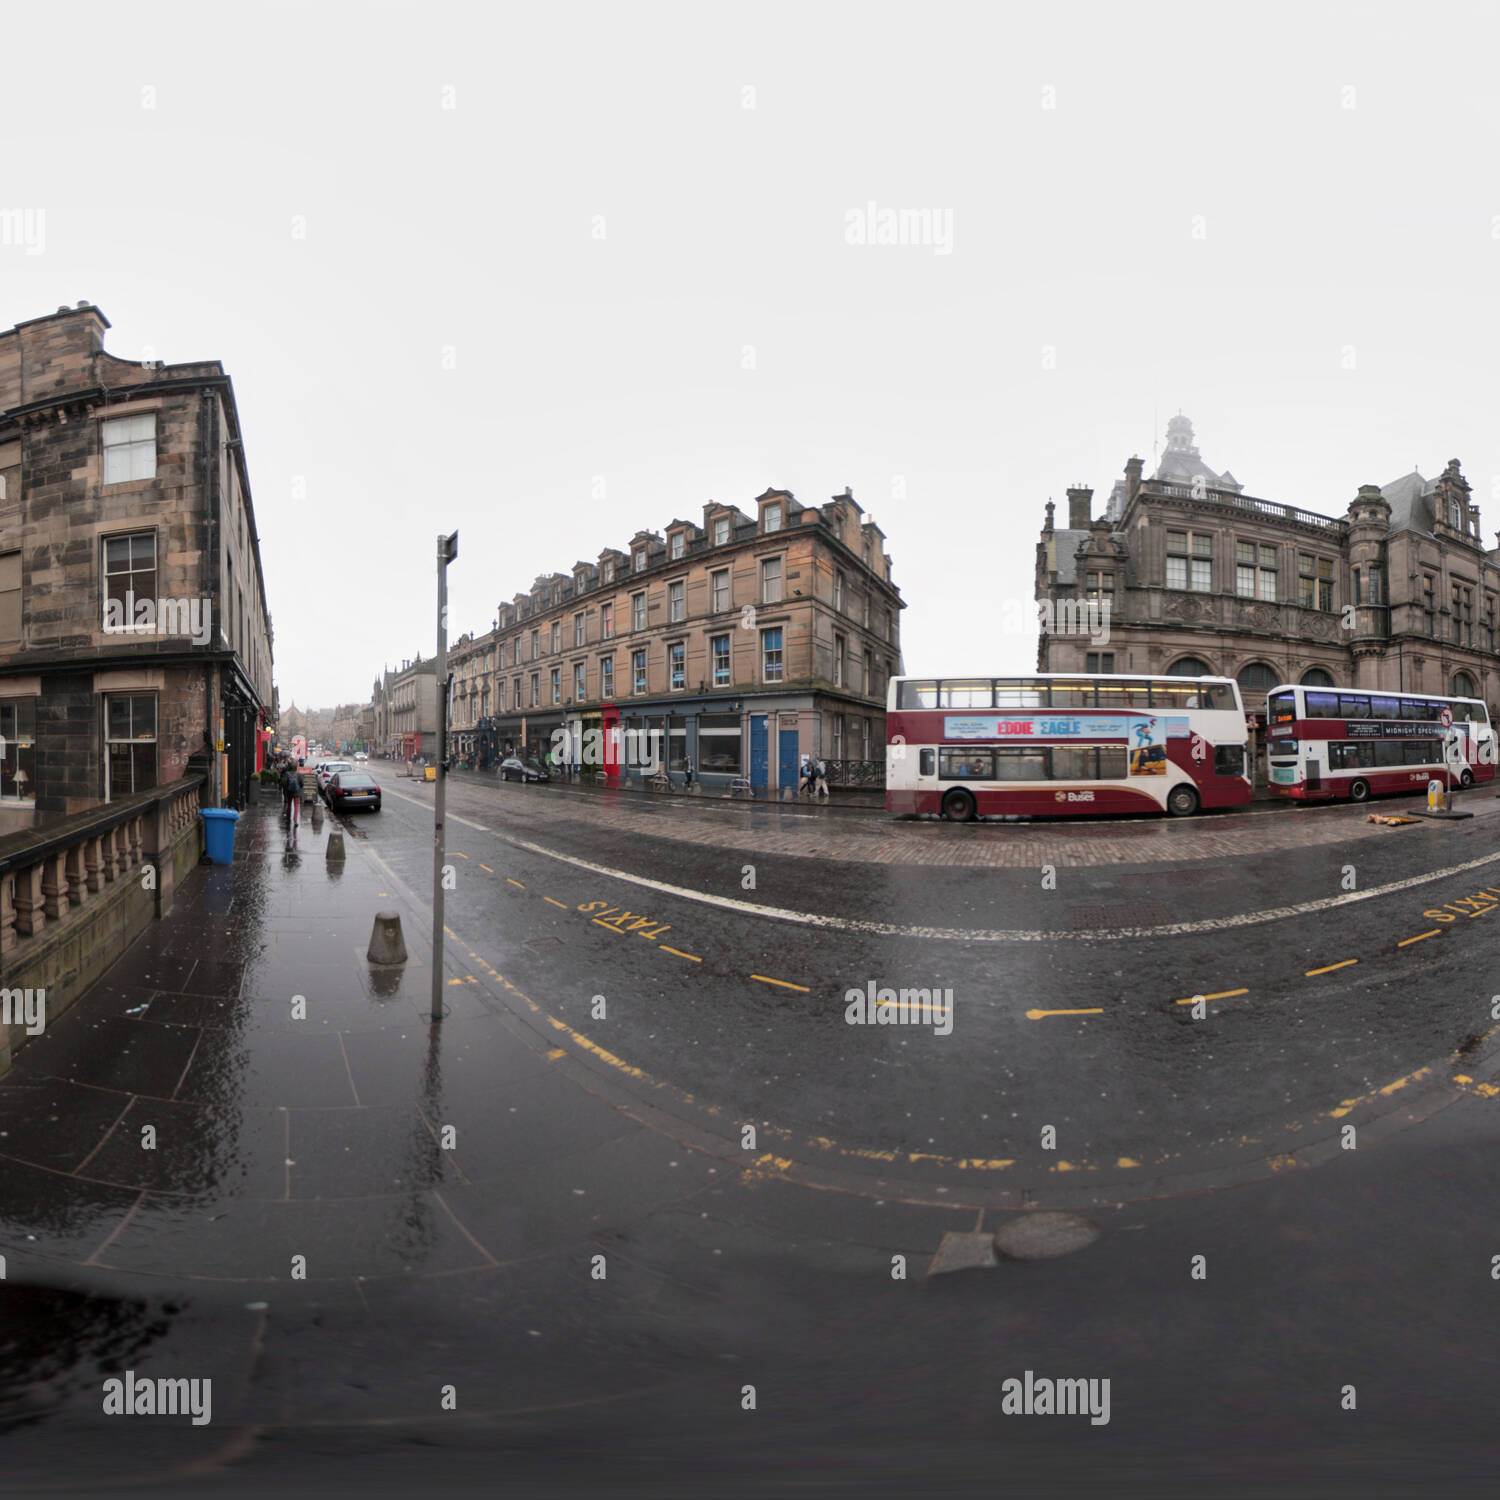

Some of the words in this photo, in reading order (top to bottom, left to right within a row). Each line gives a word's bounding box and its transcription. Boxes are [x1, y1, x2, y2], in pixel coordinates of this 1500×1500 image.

[997, 720, 1034, 735] EDDIE
[1040, 720, 1081, 735] EAGLE
[1385, 727, 1416, 735] MIDNIGHT
[1068, 792, 1095, 802] Buses
[577, 901, 671, 940] TAXIS
